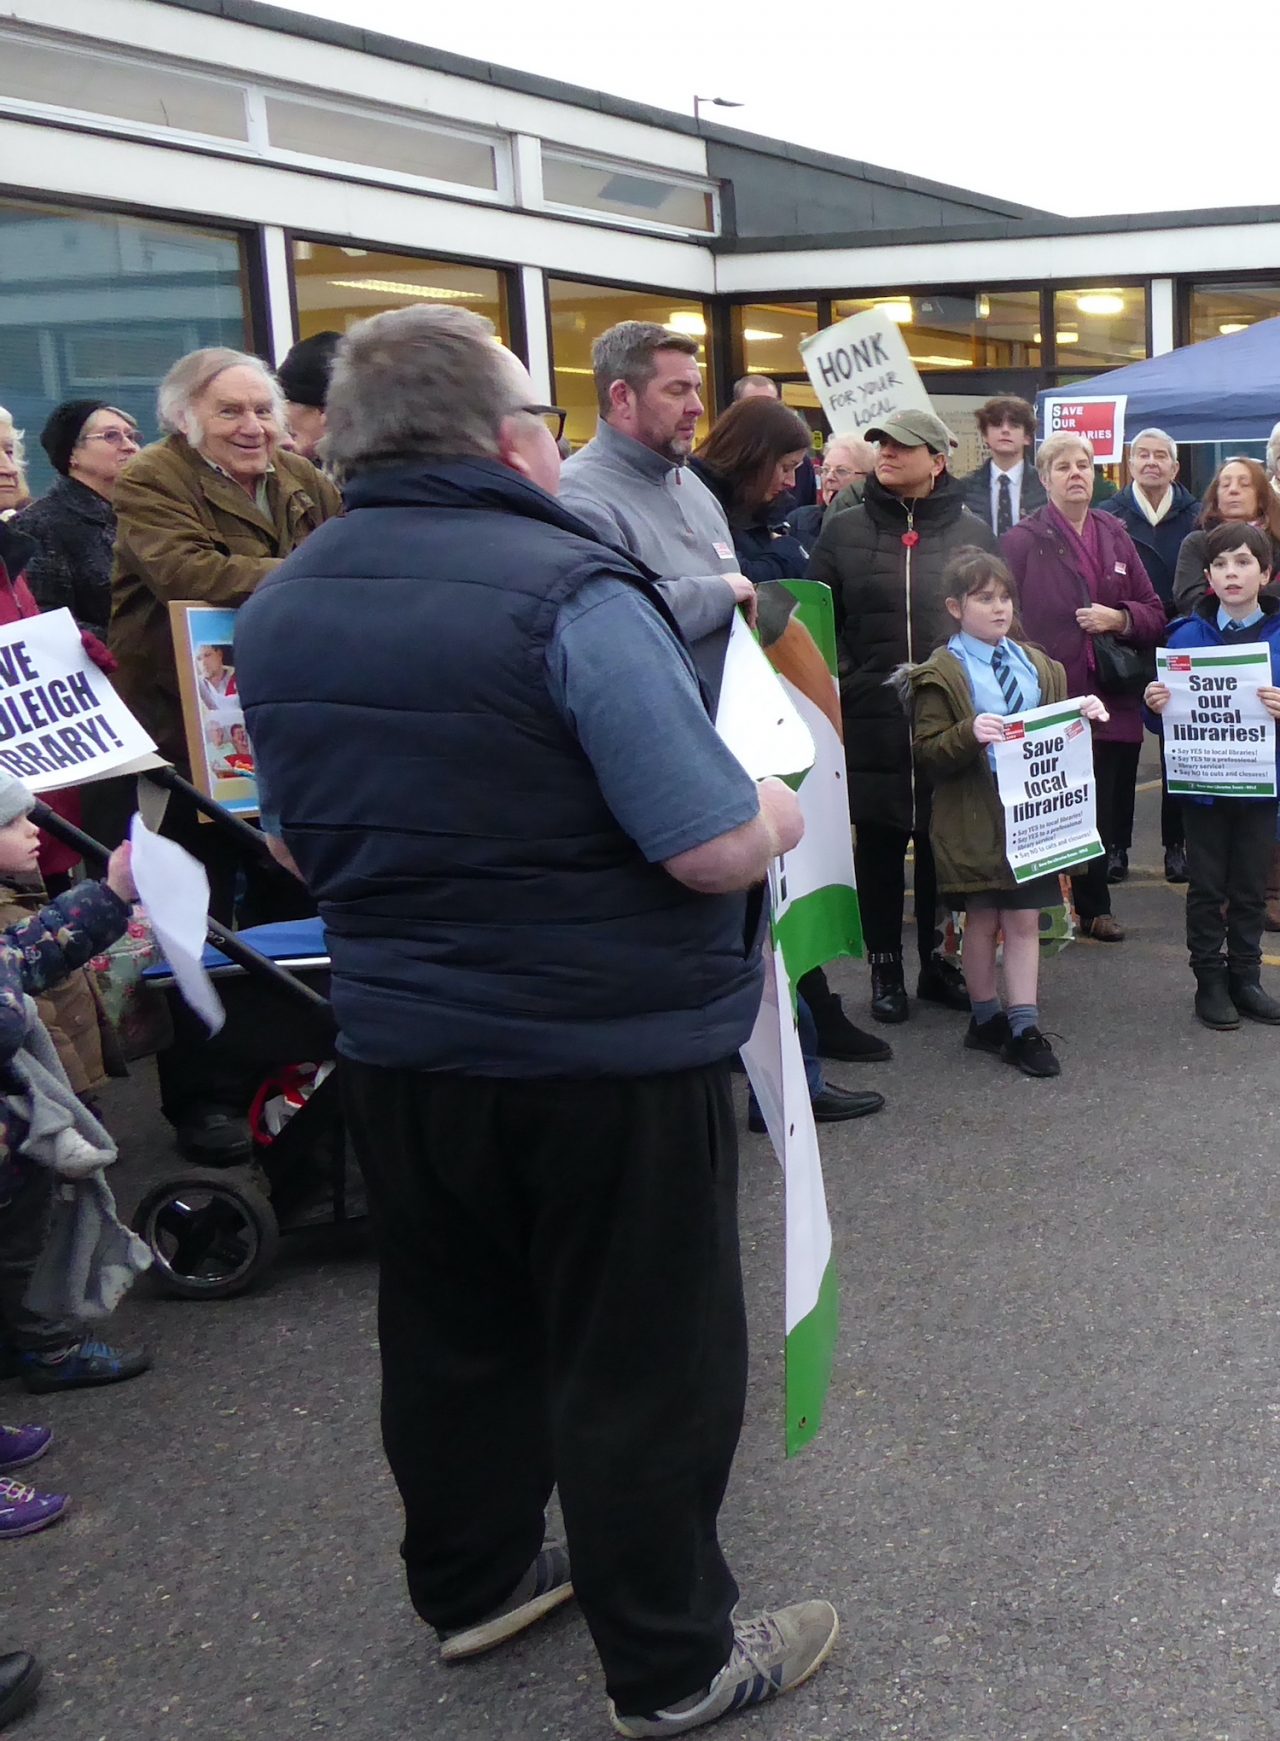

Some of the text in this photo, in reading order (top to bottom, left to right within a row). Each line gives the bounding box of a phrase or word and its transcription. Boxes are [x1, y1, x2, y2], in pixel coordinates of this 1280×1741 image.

[817, 332, 889, 387] HONK
[829, 371, 904, 411] FOR YOUR
[853, 397, 897, 427] LOCAL
[1053, 405, 1084, 417] SAVE
[1053, 418, 1076, 429] OUR
[1071, 429, 1112, 440] ARIES
[1188, 674, 1238, 691] Save
[1197, 695, 1232, 709] our
[1190, 709, 1242, 724] local
[1173, 724, 1266, 742] libraries!
[0, 714, 124, 778] IBRARY!
[1022, 736, 1064, 760] Save
[1029, 756, 1059, 778] our
[1024, 771, 1068, 799] local
[1013, 784, 1088, 823] libraries!
